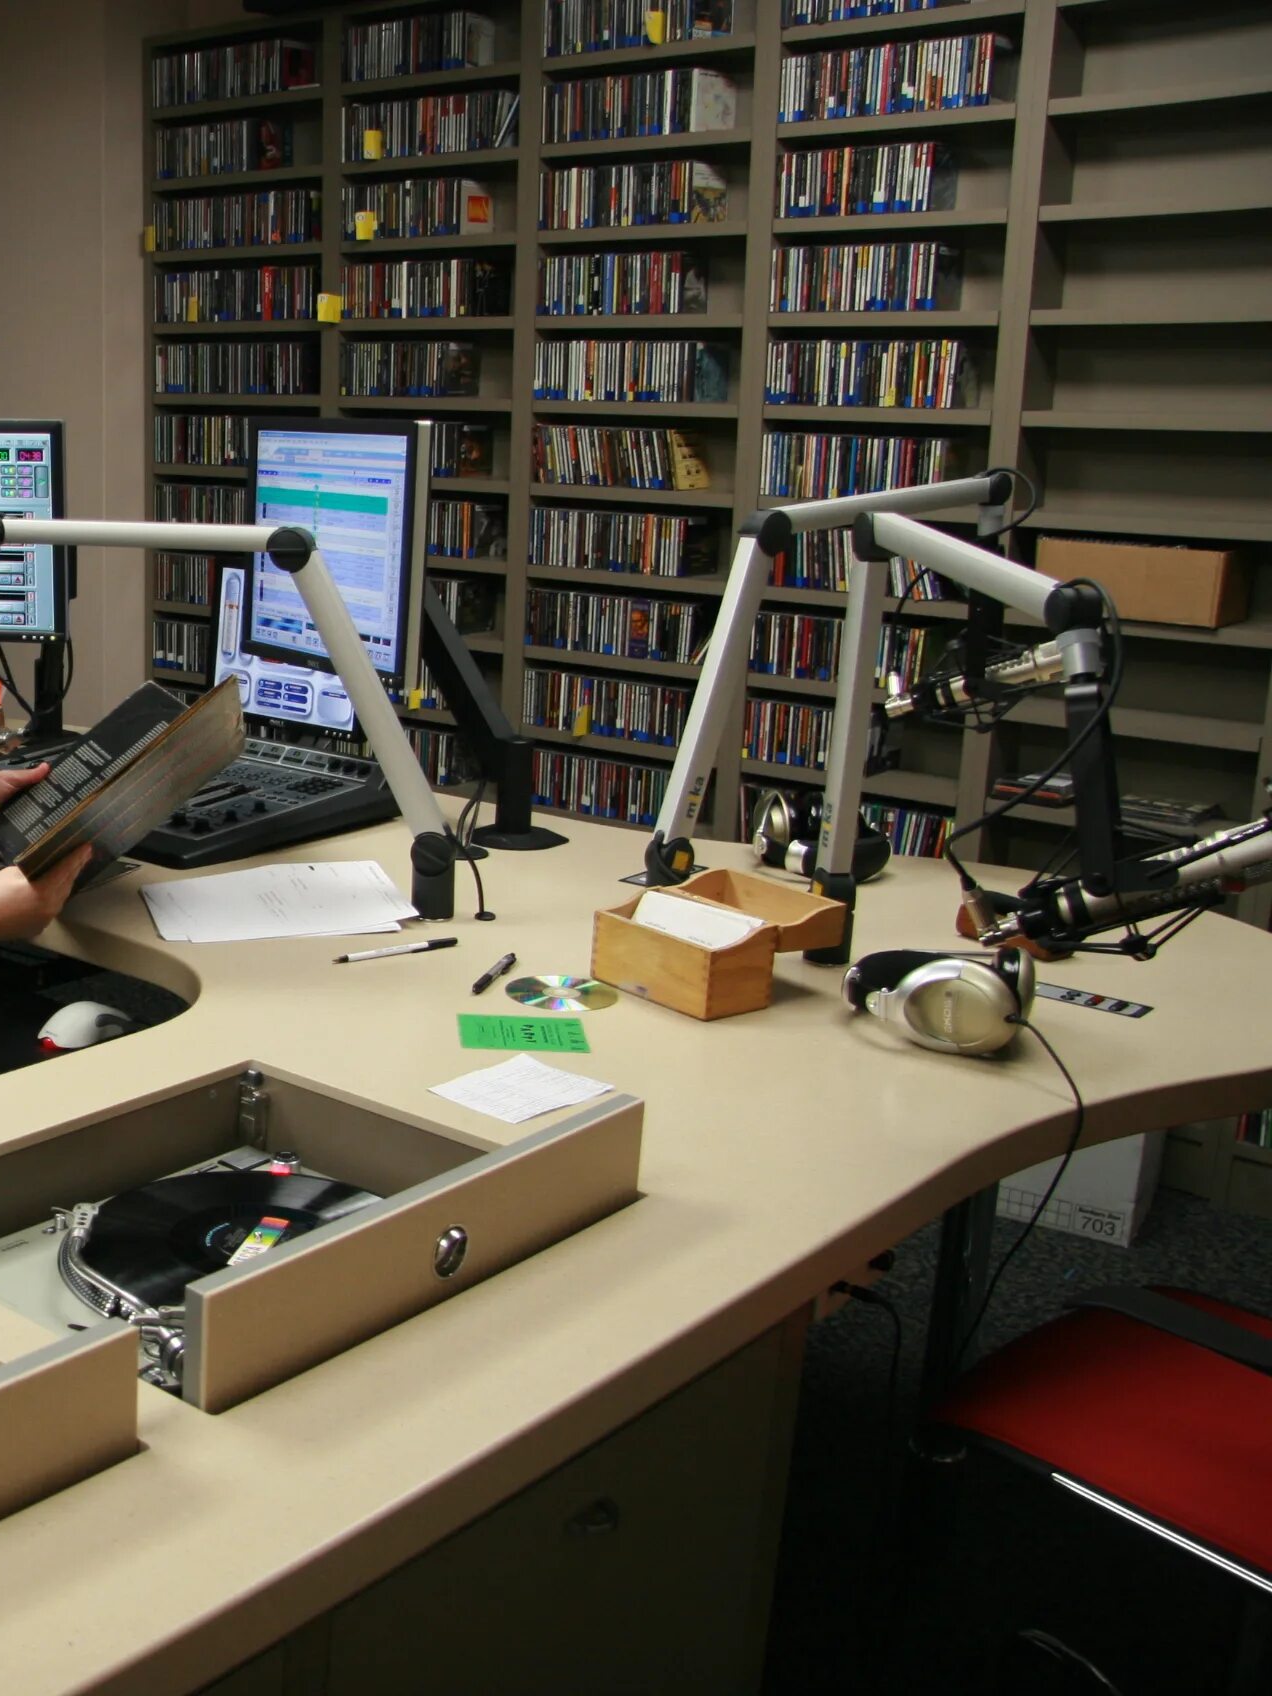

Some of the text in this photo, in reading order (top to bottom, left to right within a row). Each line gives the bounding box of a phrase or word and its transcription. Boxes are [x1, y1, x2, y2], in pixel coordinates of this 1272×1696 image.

[19, 451, 42, 461] 04:38
[686, 776, 704, 819] mika
[822, 803, 833, 848] mika
[1080, 1215, 1116, 1237] 703
